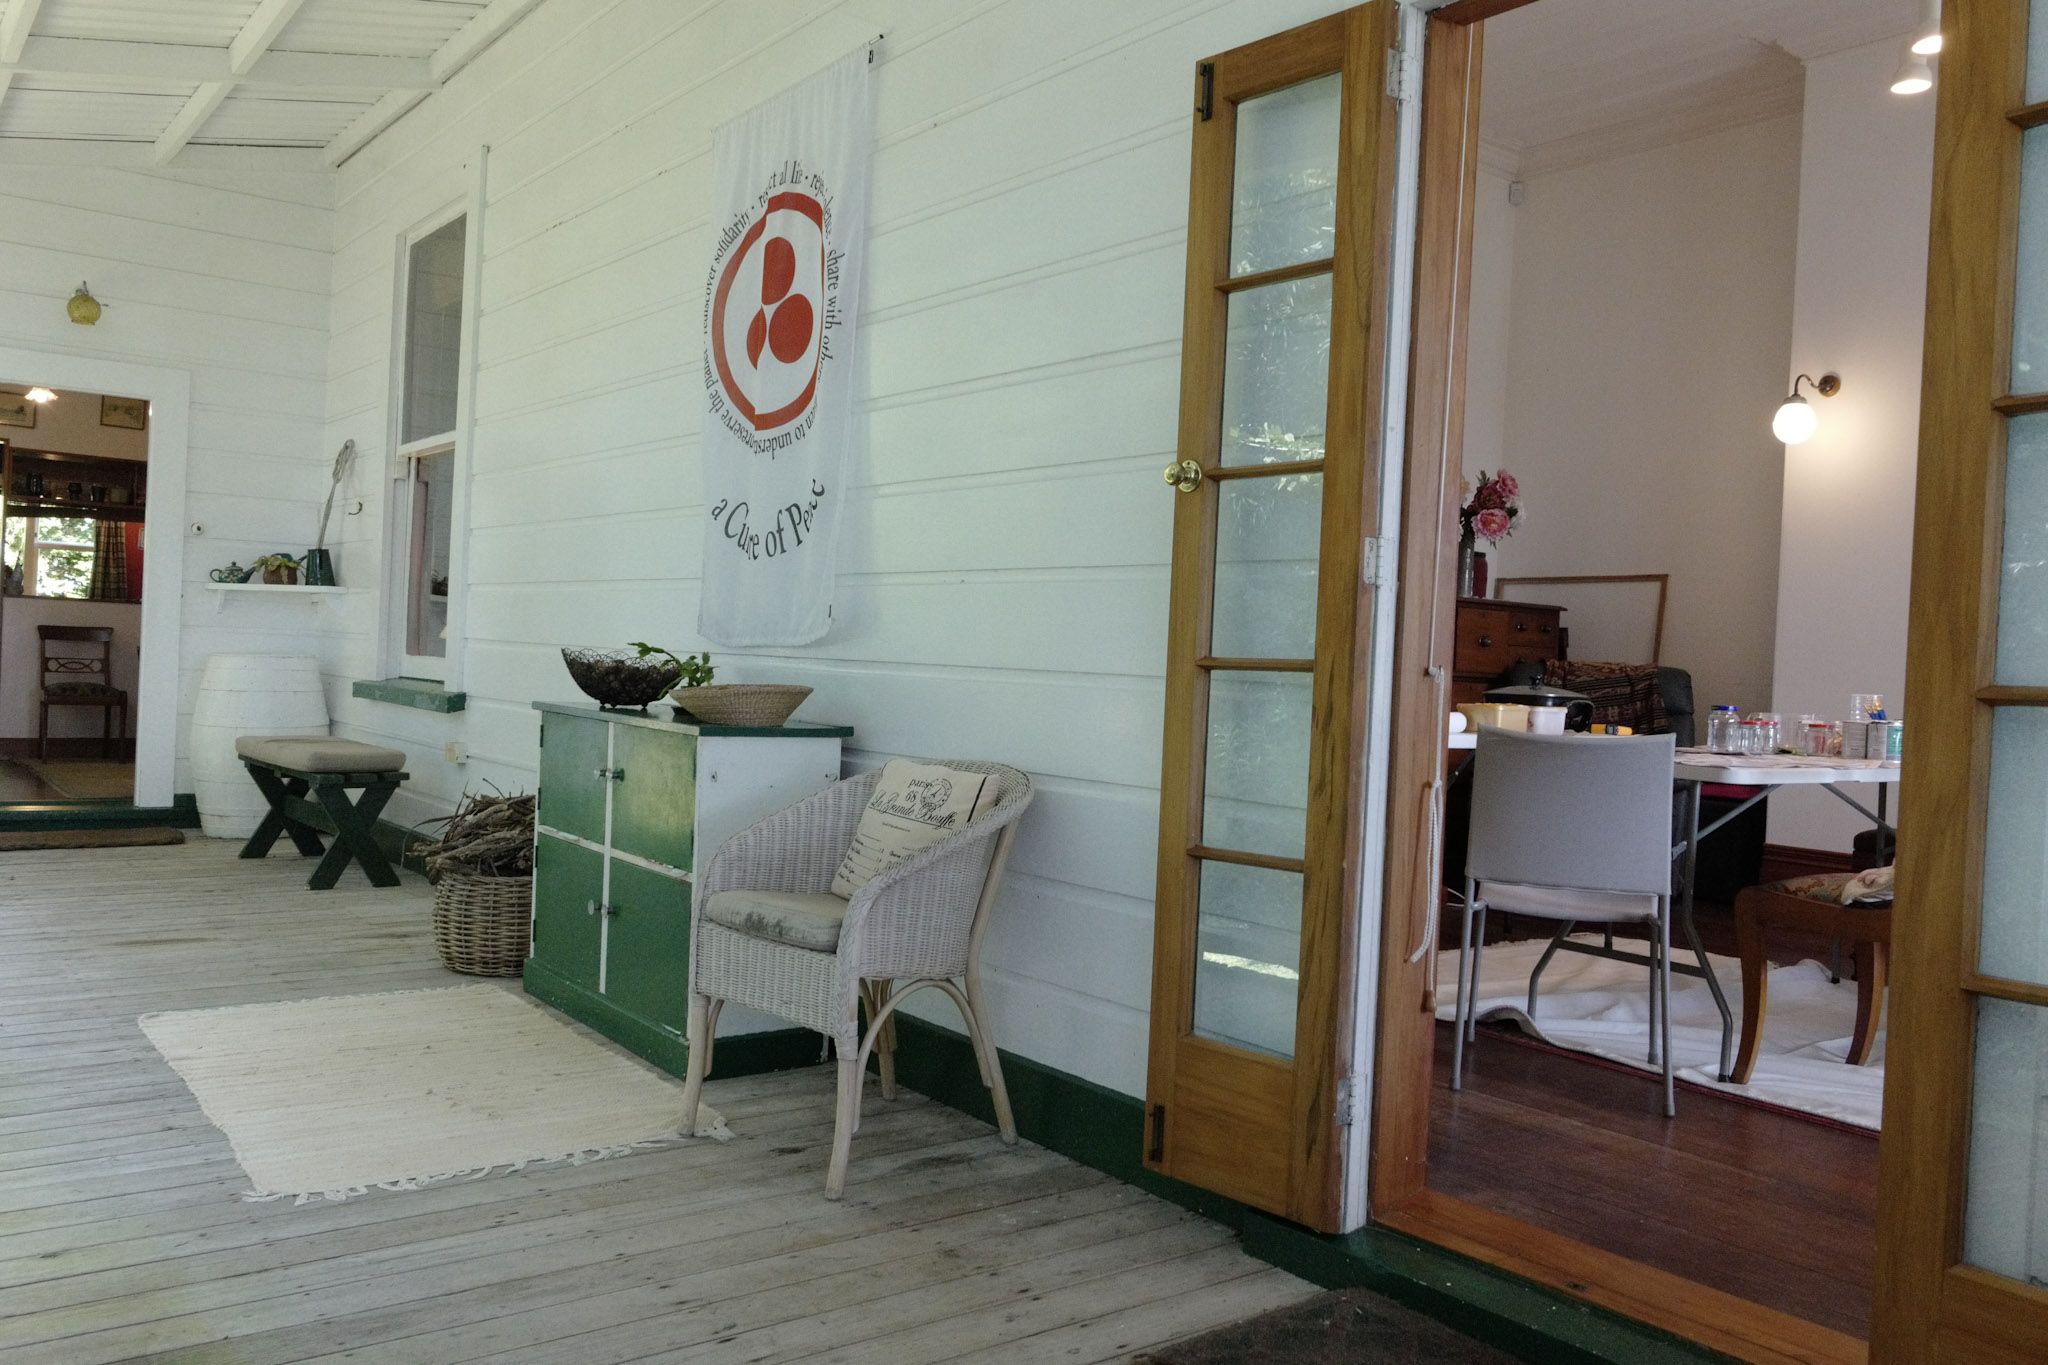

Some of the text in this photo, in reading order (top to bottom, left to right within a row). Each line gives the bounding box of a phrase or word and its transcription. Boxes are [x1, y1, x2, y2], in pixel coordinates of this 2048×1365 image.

[714, 209, 751, 264] solidarity
[827, 249, 845, 291] share
[825, 296, 842, 329] with
[709, 389, 725, 414] the
[794, 423, 806, 440] to
[711, 498, 728, 521] a
[765, 508, 787, 558] of
